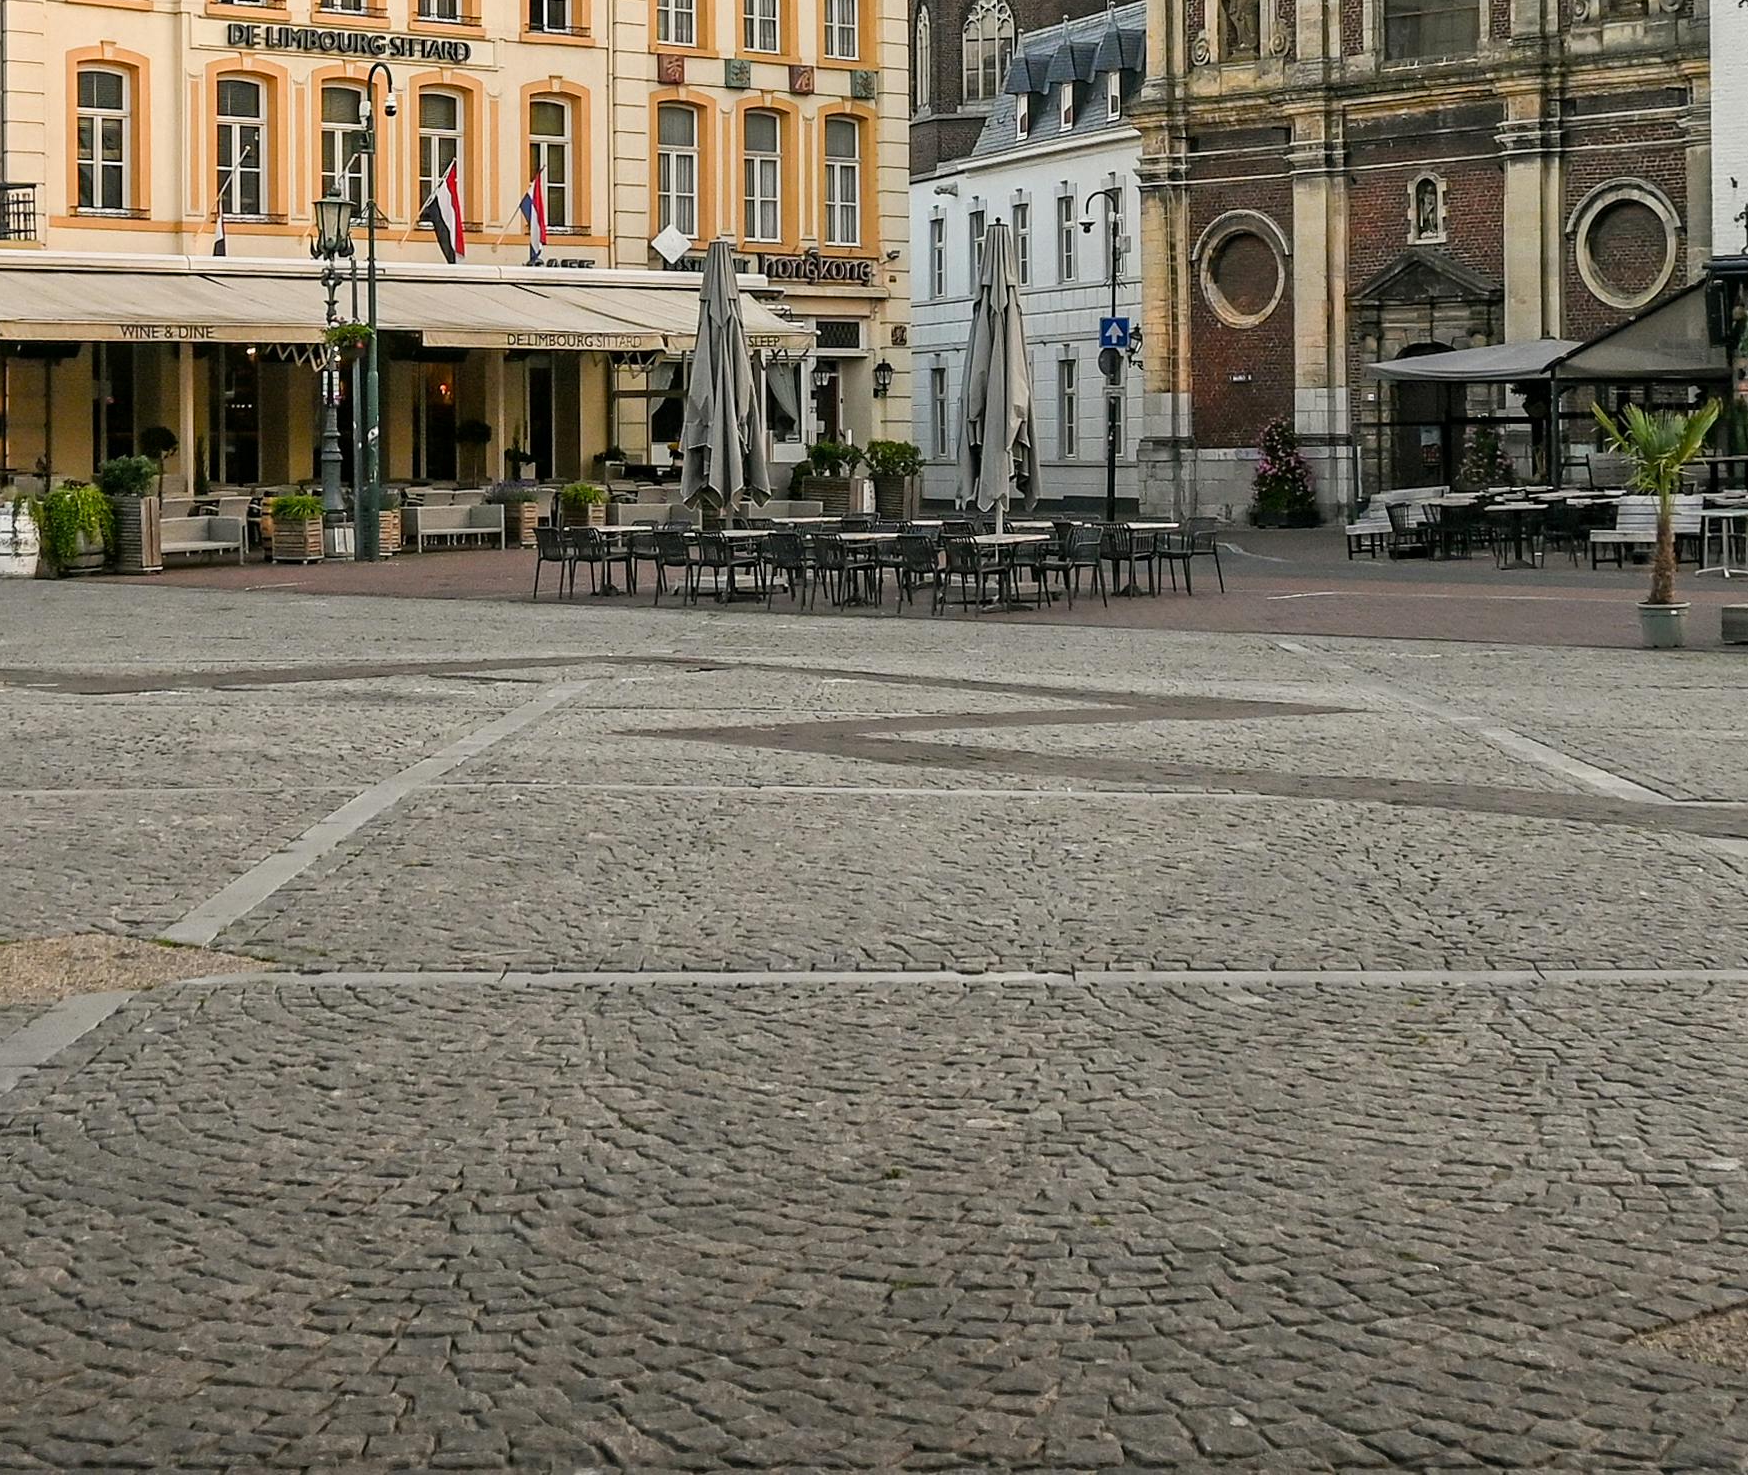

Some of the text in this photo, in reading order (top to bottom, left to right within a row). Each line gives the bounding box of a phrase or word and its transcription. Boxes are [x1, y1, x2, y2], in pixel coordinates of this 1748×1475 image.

[228, 23, 472, 63] DE LIMBOURG SITTARD
[120, 324, 215, 339] WINE & DINE
[507, 333, 642, 348] DE LIMBOURG SITTARD
[748, 335, 780, 348] SLEEP
